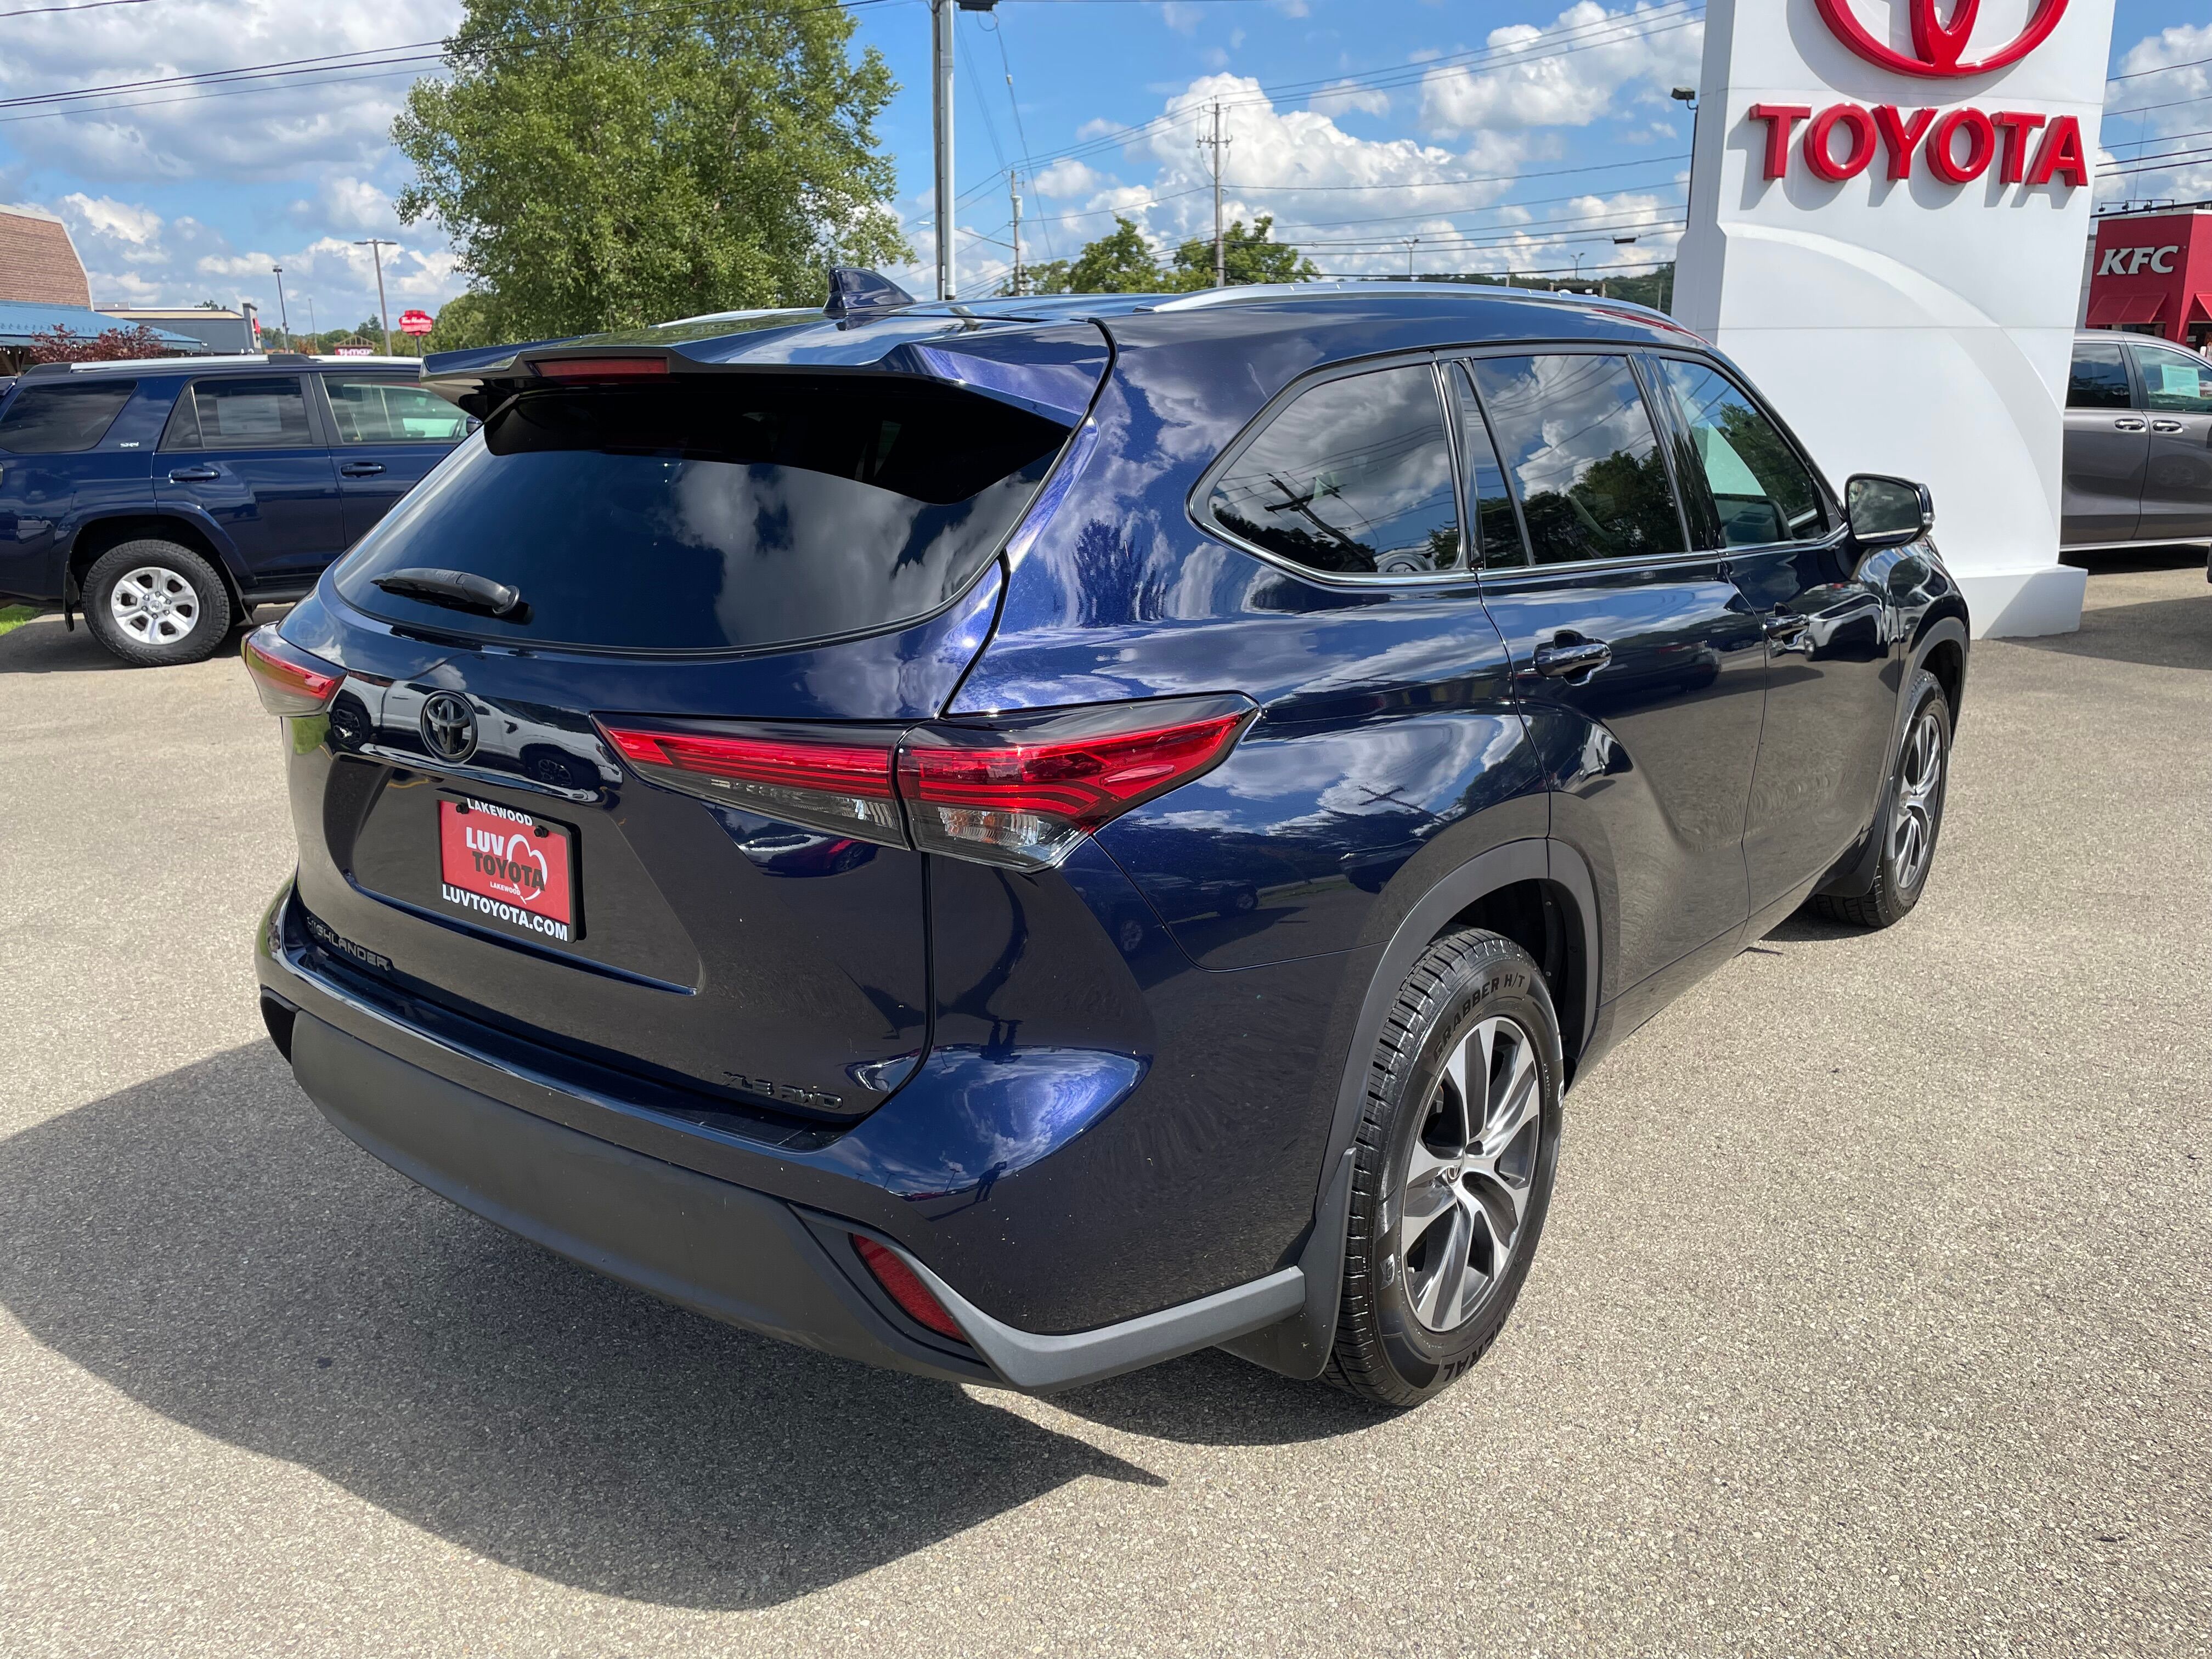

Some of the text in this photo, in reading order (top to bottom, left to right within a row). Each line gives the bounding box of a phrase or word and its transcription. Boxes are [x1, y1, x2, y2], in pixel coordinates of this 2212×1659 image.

[1749, 102, 2089, 187] TOYOTA
[2096, 245, 2179, 276] KFC
[466, 798, 533, 826] LAKEWOOD
[466, 827, 505, 856] LUV
[472, 851, 545, 891] TOYOTA
[490, 881, 521, 896] LAKEWOOD
[442, 884, 568, 942] LUVTOYOTA.COM
[1432, 977, 1500, 1064] GRABBER
[1503, 972, 1526, 989] H/T
[722, 1071, 773, 1097] XLE
